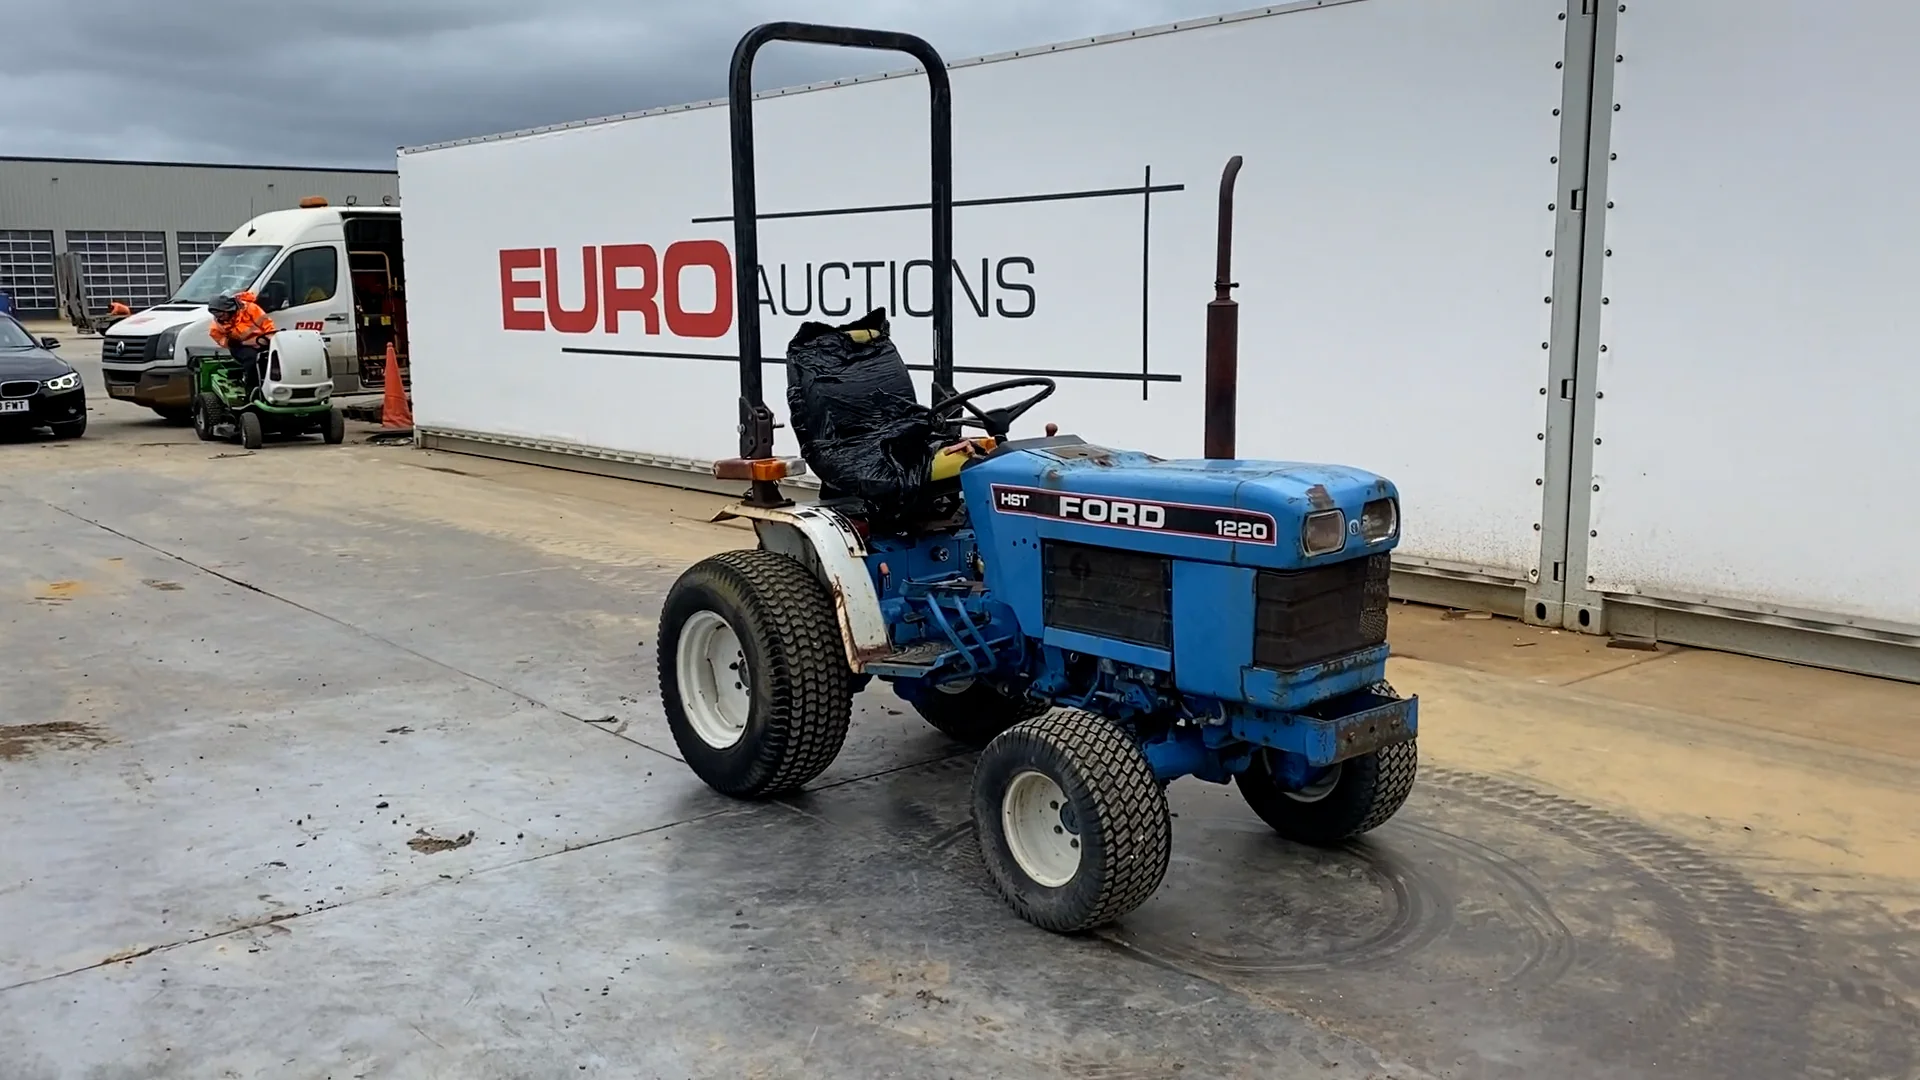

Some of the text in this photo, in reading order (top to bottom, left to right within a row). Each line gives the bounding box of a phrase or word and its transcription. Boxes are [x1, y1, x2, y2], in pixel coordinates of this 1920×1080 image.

[499, 240, 734, 338] EURO
[1000, 492, 1268, 540] HST FORD 1220
